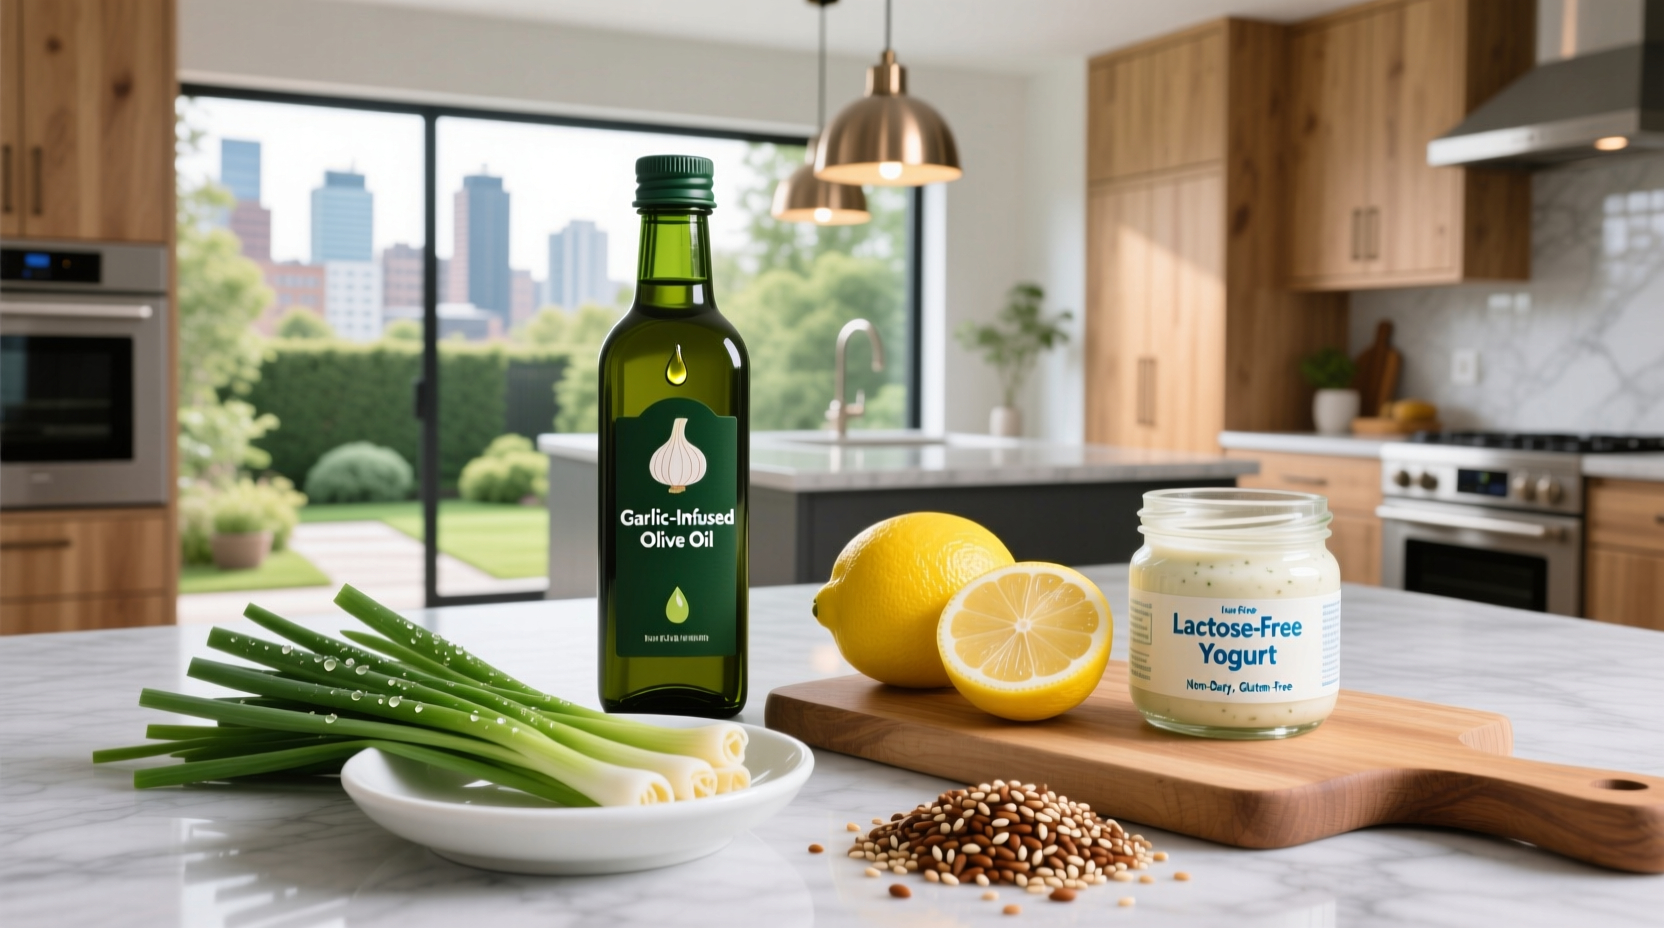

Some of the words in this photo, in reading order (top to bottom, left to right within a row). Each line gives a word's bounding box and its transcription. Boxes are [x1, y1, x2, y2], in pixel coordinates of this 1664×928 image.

[620, 508, 735, 526] Garlic-Infused
[640, 531, 685, 548] Olive
[689, 530, 714, 548] Oil
[1173, 612, 1303, 638] Lactose-Free
[1198, 642, 1278, 672] Yogurt
